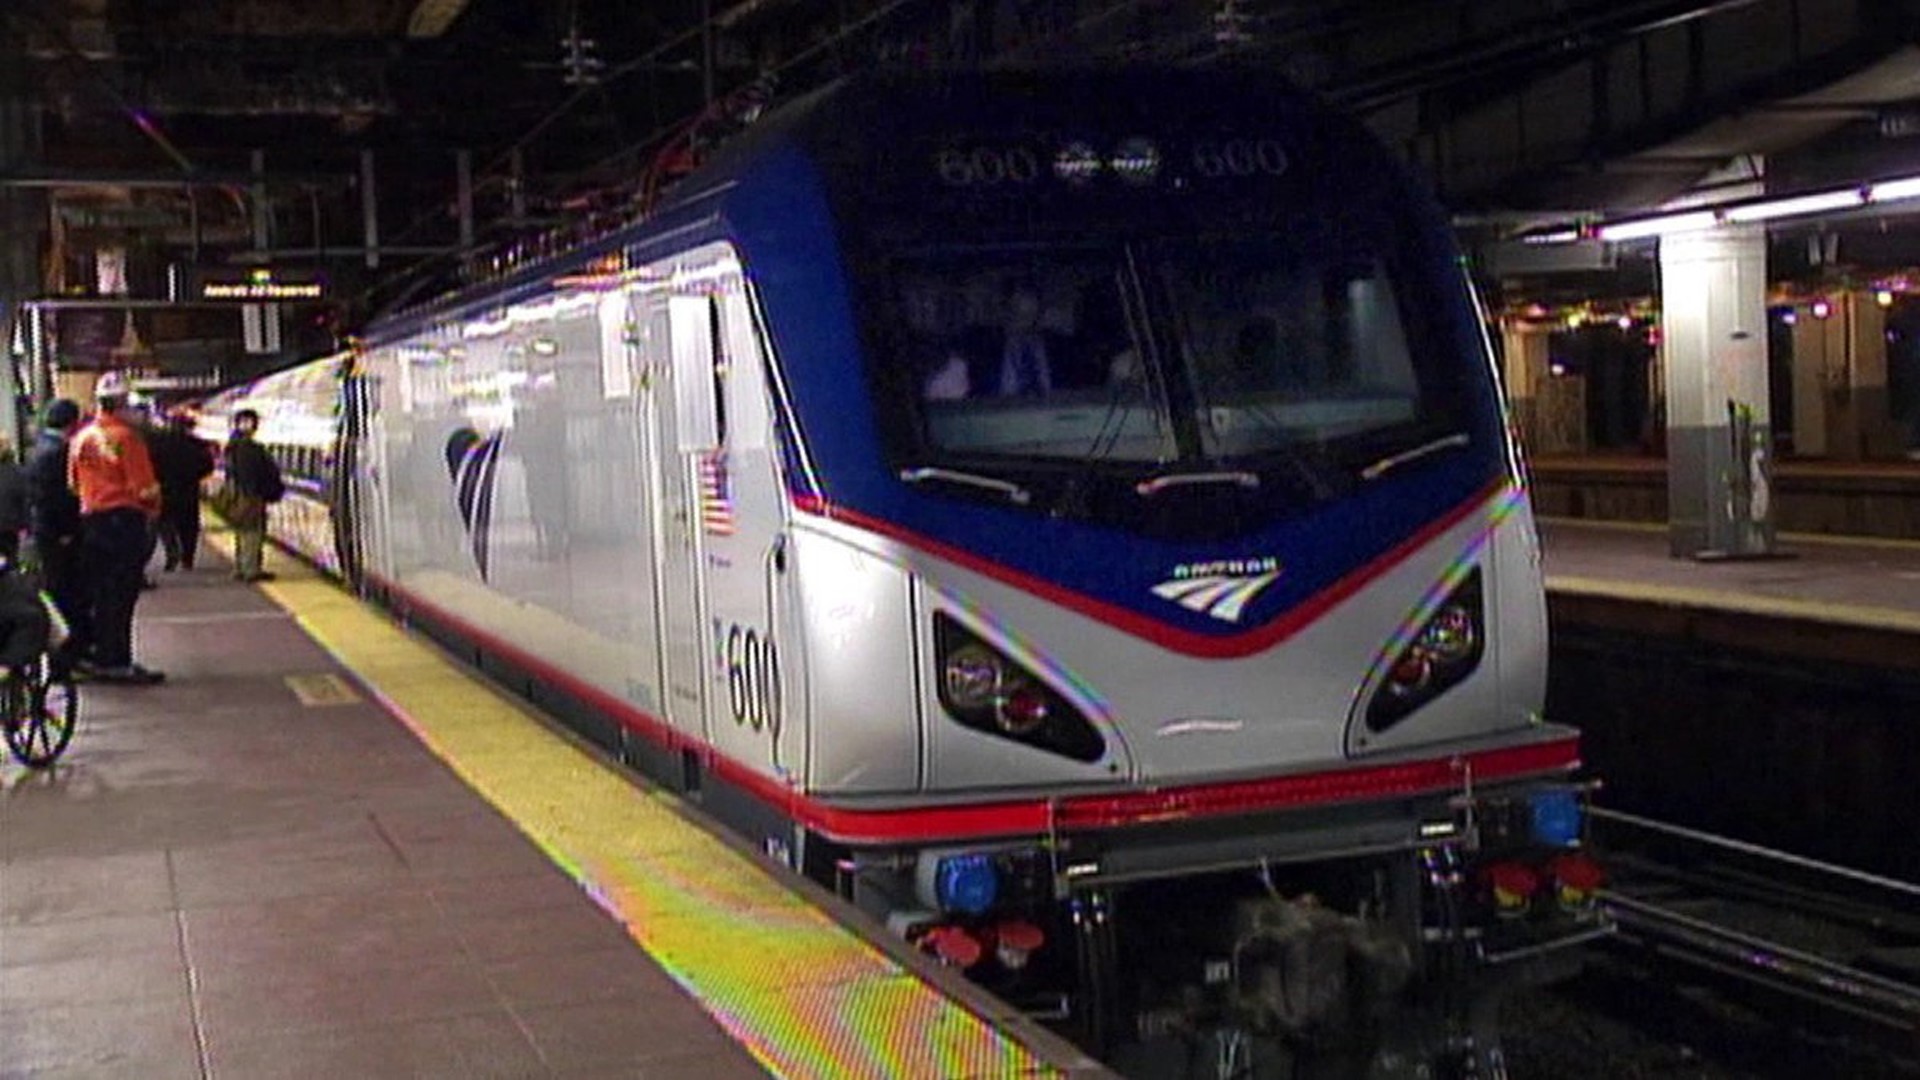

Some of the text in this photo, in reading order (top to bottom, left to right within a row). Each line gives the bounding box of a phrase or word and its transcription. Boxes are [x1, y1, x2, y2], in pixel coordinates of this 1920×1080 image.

[937, 147, 1037, 185] 600
[1193, 138, 1288, 176] 600
[728, 622, 780, 734] 600
